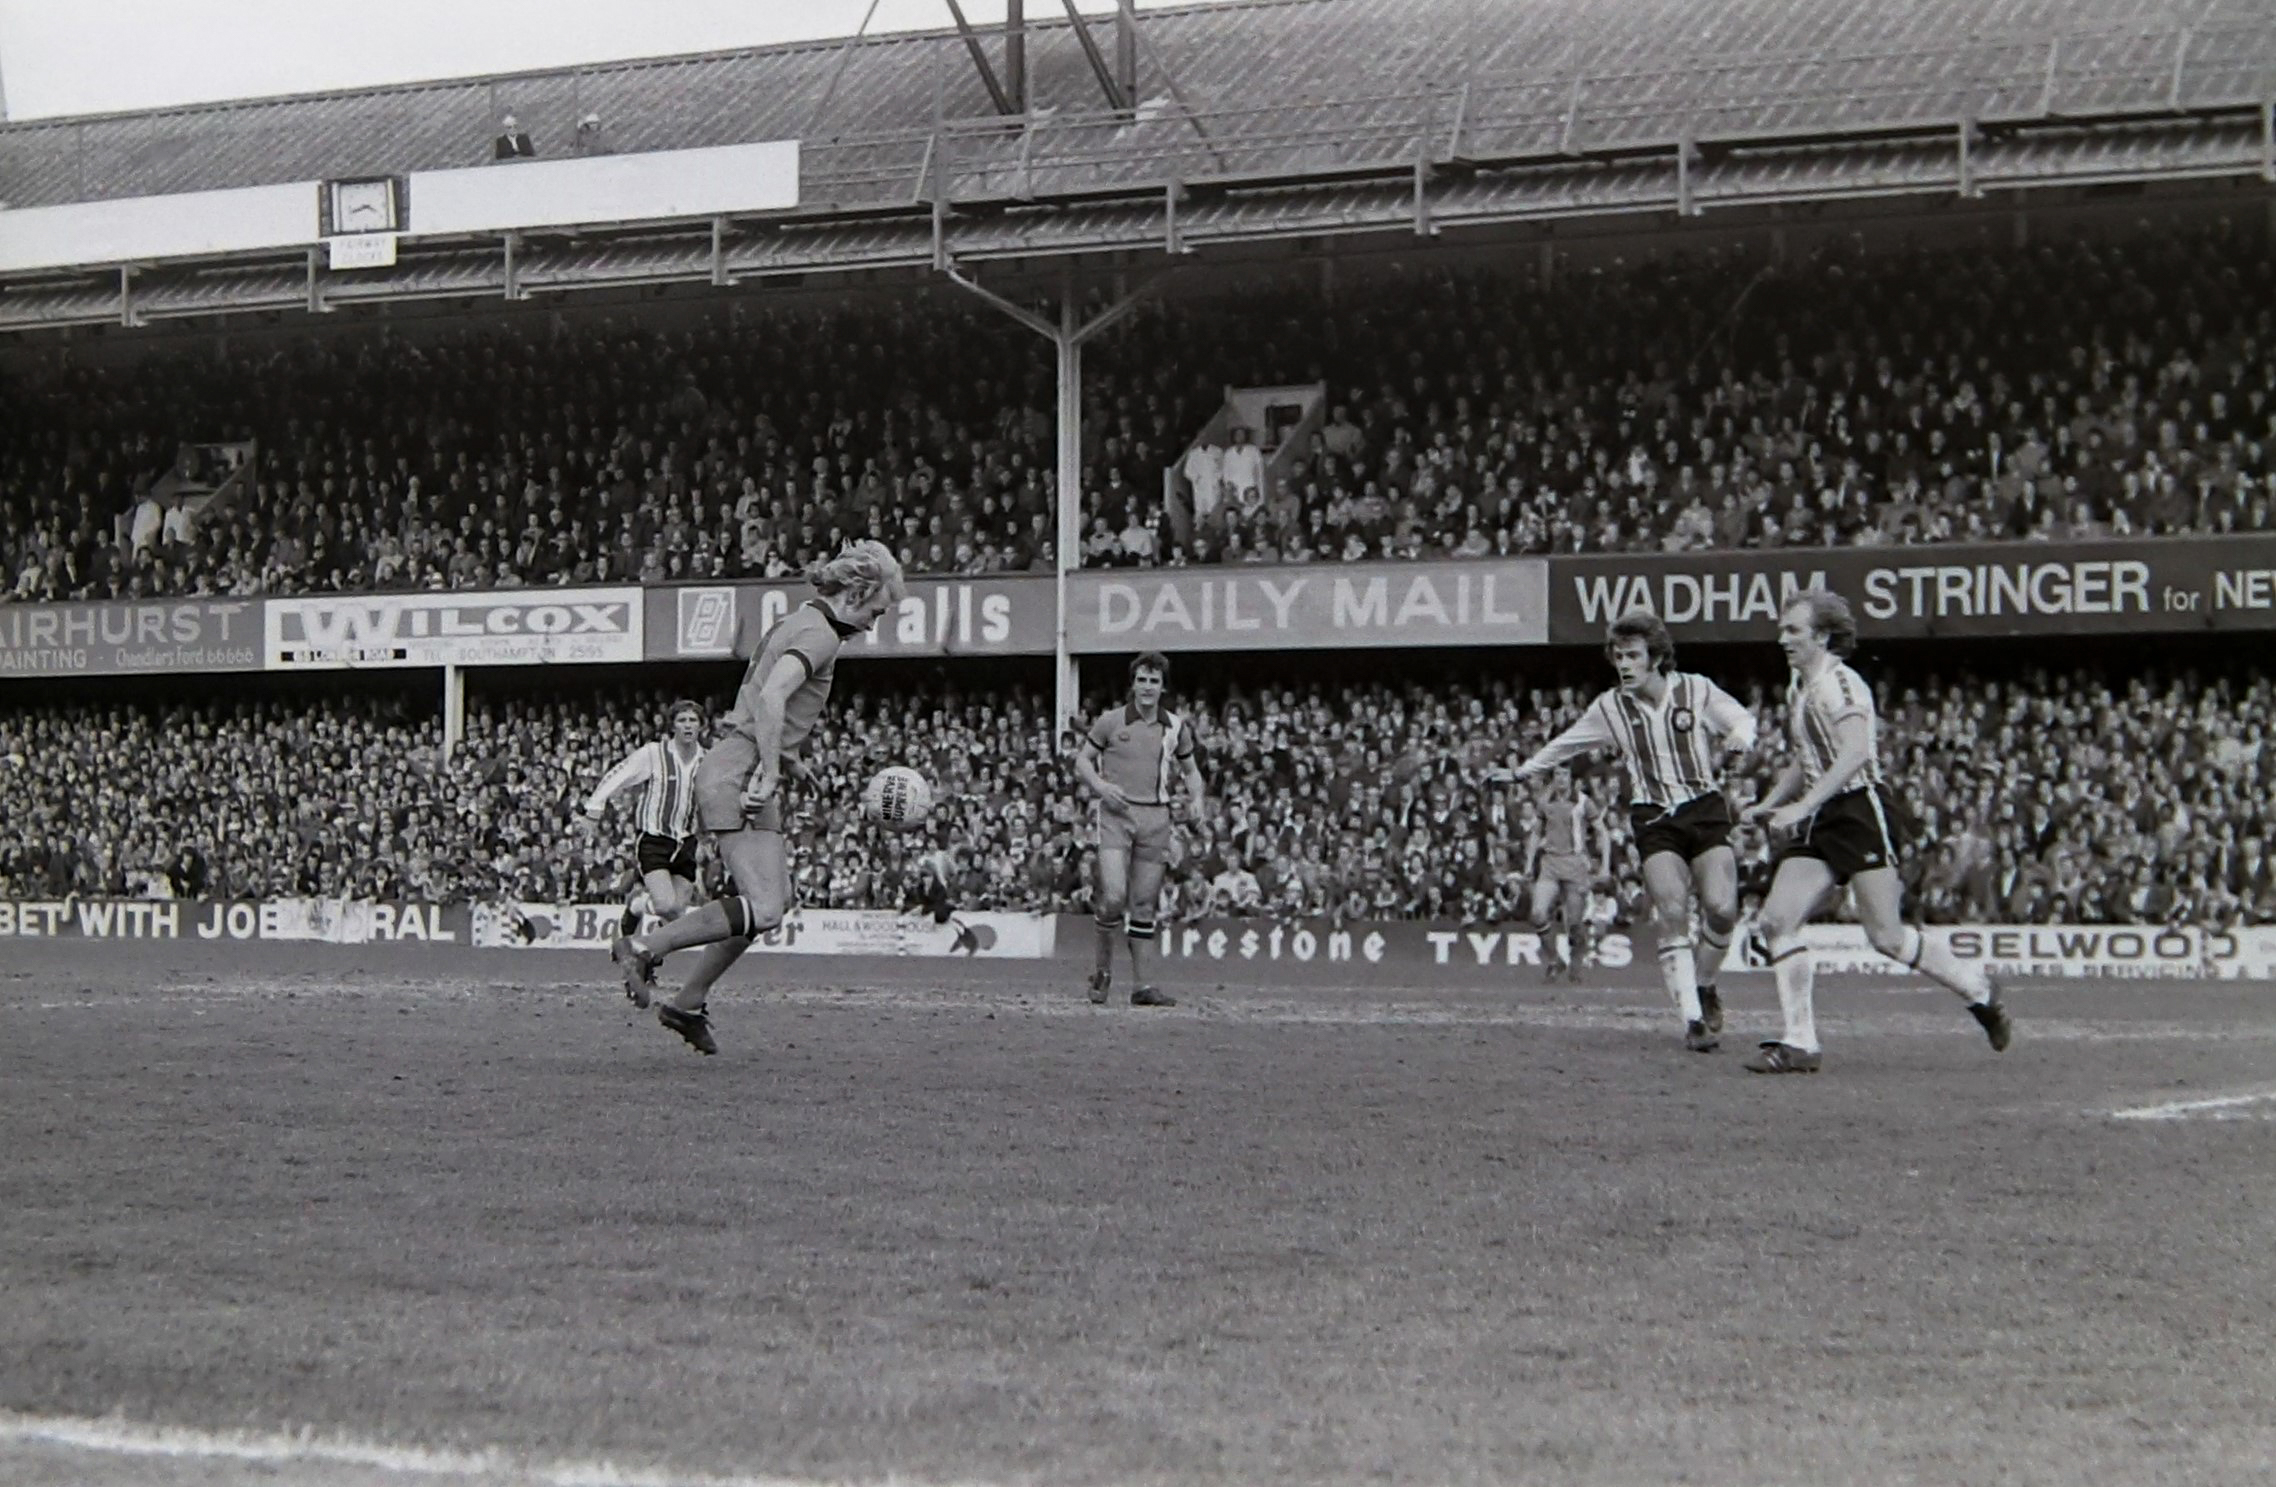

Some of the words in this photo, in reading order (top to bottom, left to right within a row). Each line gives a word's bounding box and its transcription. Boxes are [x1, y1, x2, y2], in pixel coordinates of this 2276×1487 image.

[1099, 577, 1309, 633] DAILY
[1332, 574, 1519, 629] MAIL
[1863, 560, 2150, 619] STRINGER
[2163, 586, 2200, 612] for
[2215, 569, 2276, 609] NE
[0, 604, 243, 648] IRHURST
[301, 602, 622, 648] WILCOX
[760, 585, 1011, 643] Calls
[0, 649, 87, 669] AINTING
[0, 902, 65, 936] BET
[78, 901, 179, 938] WITH
[197, 902, 278, 939] JOE
[1161, 924, 1386, 963] irestone
[1949, 932, 2237, 960] SELWOOD
